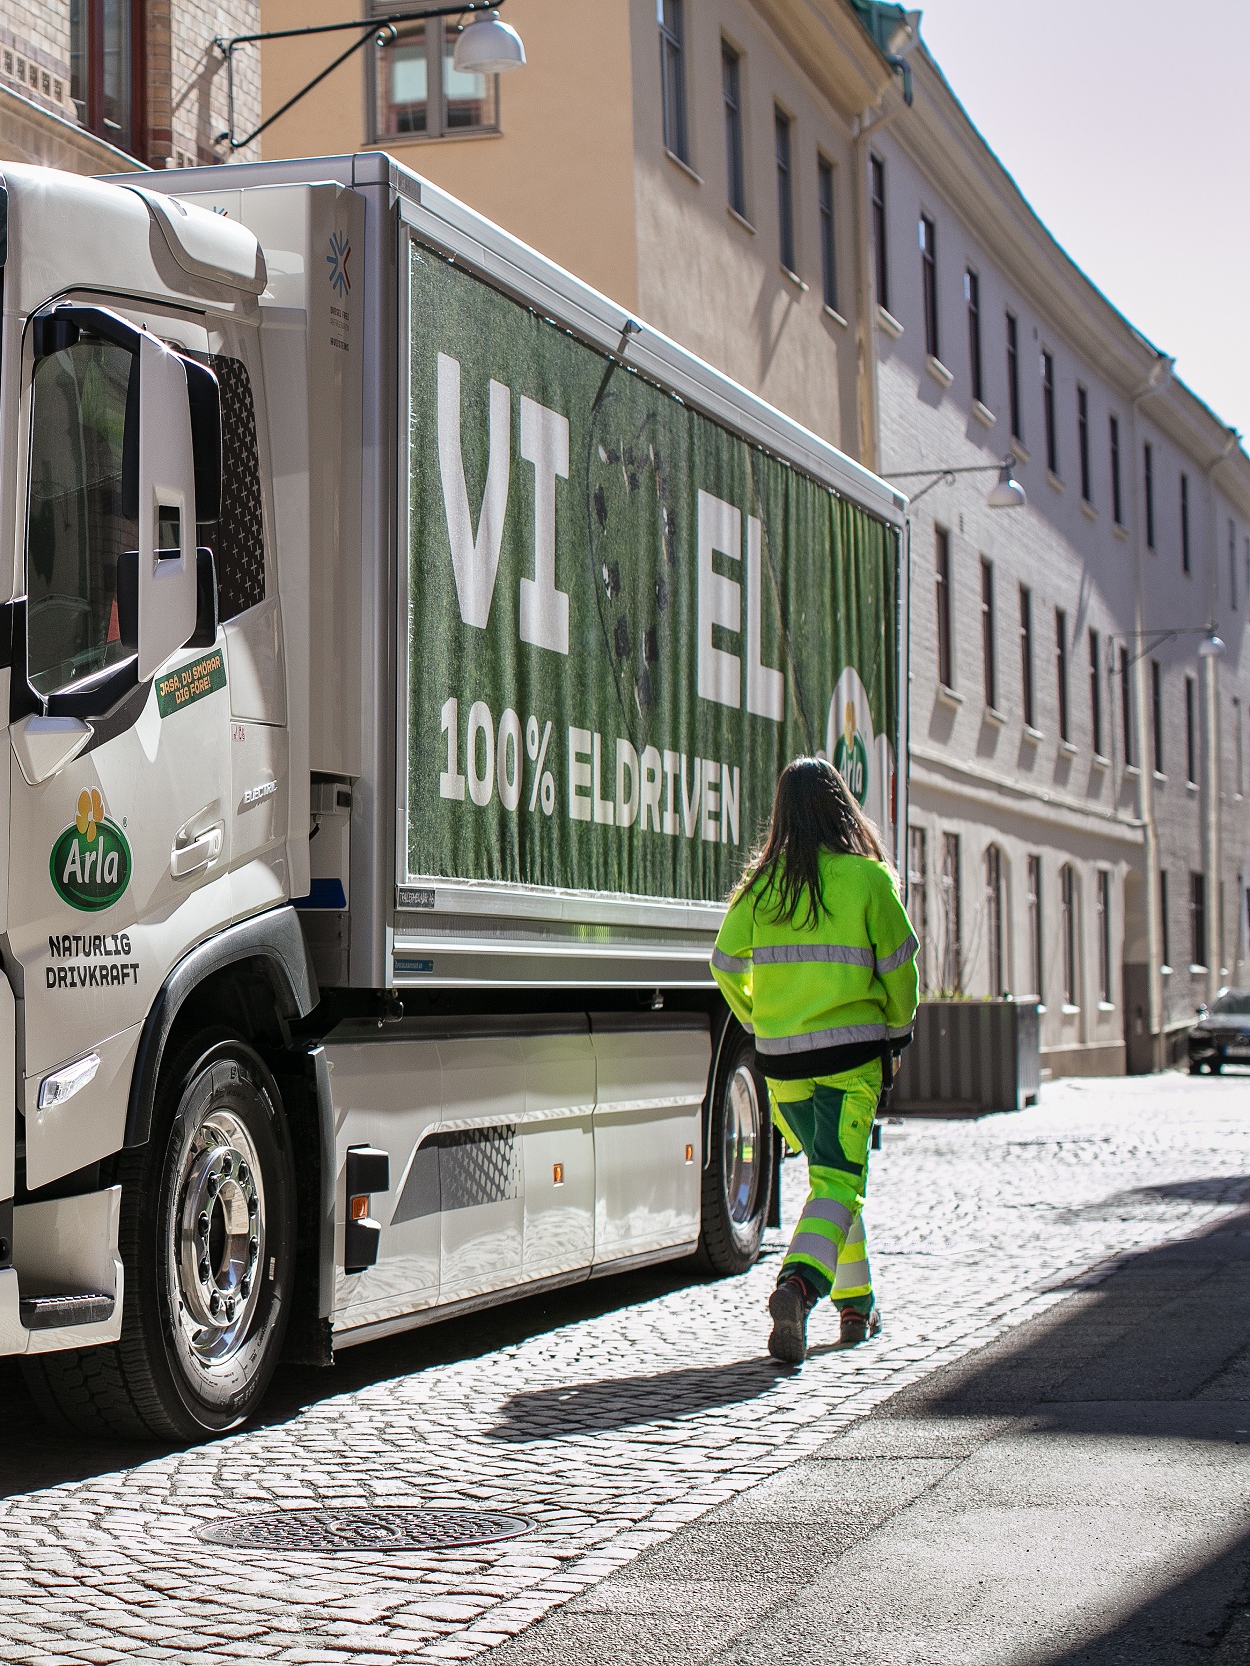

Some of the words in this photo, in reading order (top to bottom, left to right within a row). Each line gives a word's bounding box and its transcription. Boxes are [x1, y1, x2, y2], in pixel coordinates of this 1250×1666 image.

[437, 351, 569, 655] VI
[697, 488, 784, 723] EL
[182, 670, 192, 685] DU
[193, 656, 221, 680] SMÖRAR
[175, 687, 189, 704] DIG
[190, 676, 211, 696] FÖRE!
[440, 697, 554, 816] 100%
[568, 725, 740, 846] ELDRIVEN
[62, 836, 119, 884] Arla
[49, 933, 131, 958] NATURLIG
[46, 963, 139, 988] DRIVKRAFT
